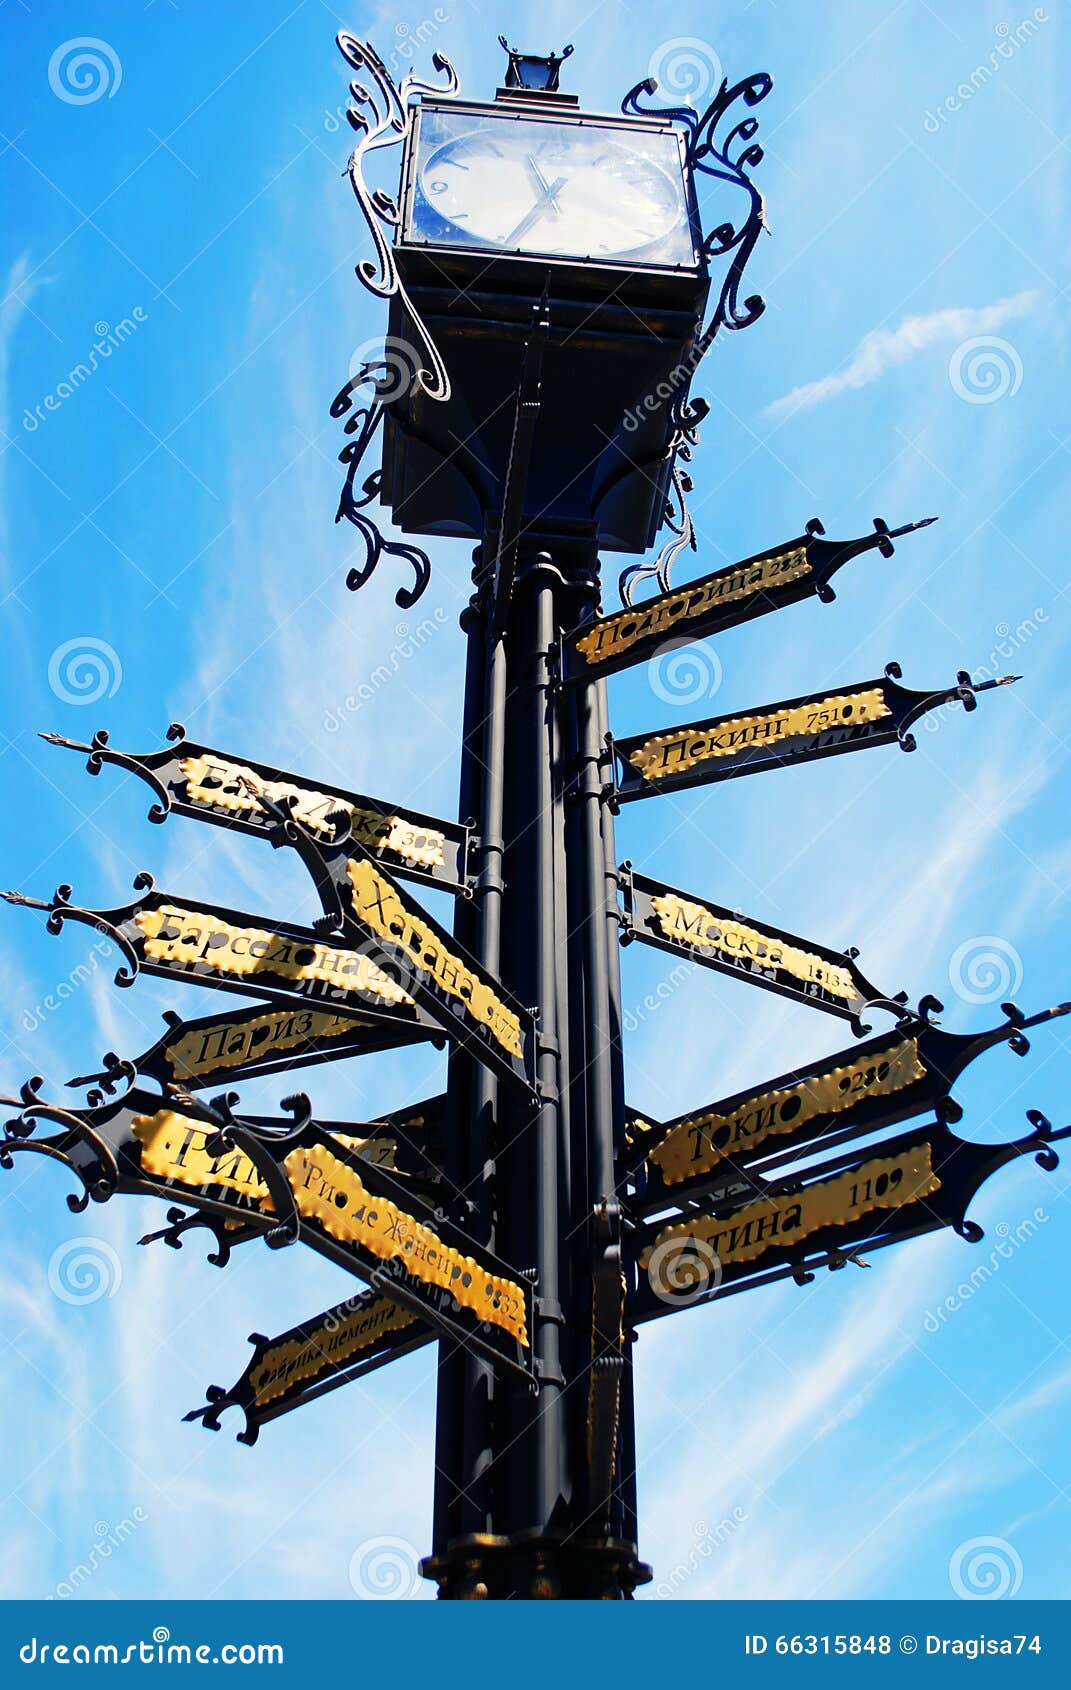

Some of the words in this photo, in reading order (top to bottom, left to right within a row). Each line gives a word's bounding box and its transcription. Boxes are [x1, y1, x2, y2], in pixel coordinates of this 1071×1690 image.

[595, 568, 764, 650] Подгорица
[658, 717, 789, 769] Пекинг
[807, 704, 853, 728] 7510
[157, 913, 361, 977] Барселона
[363, 880, 473, 1005] Хавана
[674, 906, 784, 966] Москва
[808, 964, 841, 988] 1813
[194, 1011, 313, 1064] Париз
[688, 1095, 802, 1162] Токио
[302, 1163, 349, 1209] Рио
[351, 1204, 379, 1228] де
[848, 1167, 904, 1208] 1109
